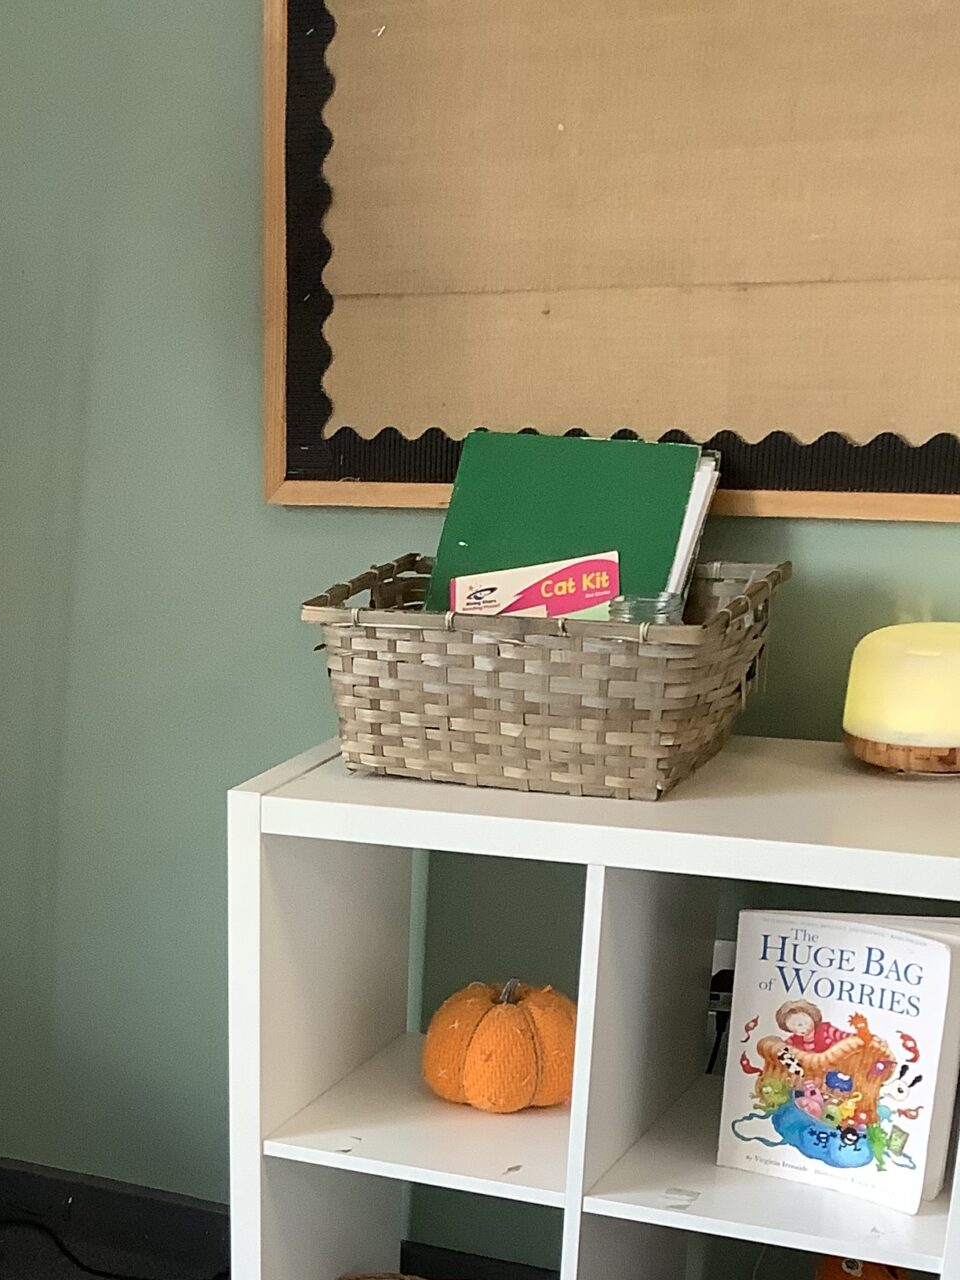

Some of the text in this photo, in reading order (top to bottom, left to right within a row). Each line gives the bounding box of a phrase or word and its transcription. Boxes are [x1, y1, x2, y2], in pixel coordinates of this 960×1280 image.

[541, 577, 577, 599] Cat
[582, 571, 610, 592] Kit
[791, 927, 819, 944] The
[759, 934, 924, 986] HUGE BAG
[759, 965, 921, 1018] of WORRIES
